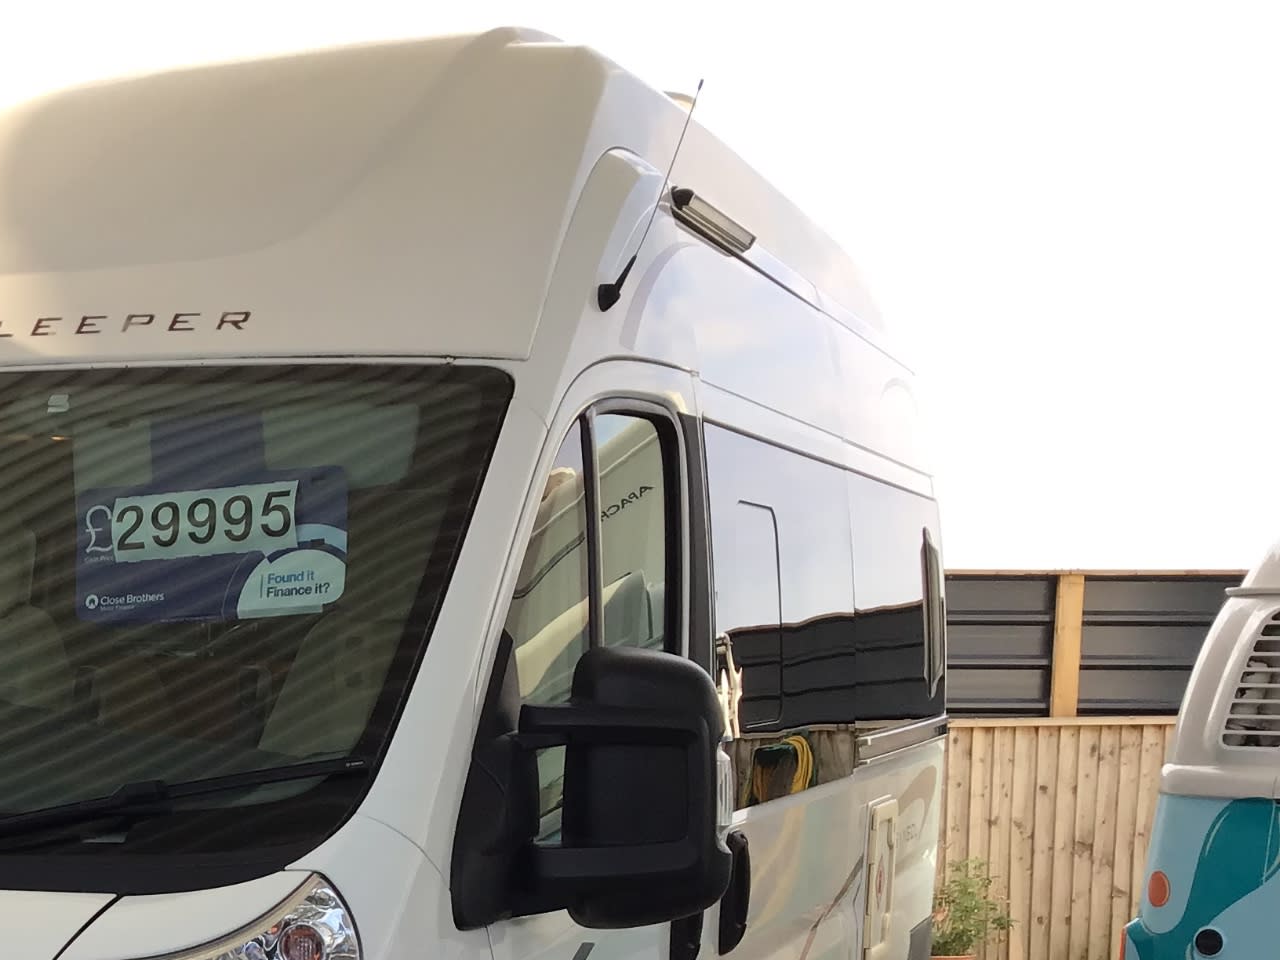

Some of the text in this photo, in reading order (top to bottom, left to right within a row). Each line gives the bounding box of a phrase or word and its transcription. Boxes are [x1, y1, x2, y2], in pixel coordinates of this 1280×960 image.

[267, 569, 315, 585] Found it
[266, 581, 331, 599] Finance it?
[100, 592, 166, 606] Close Brothers
